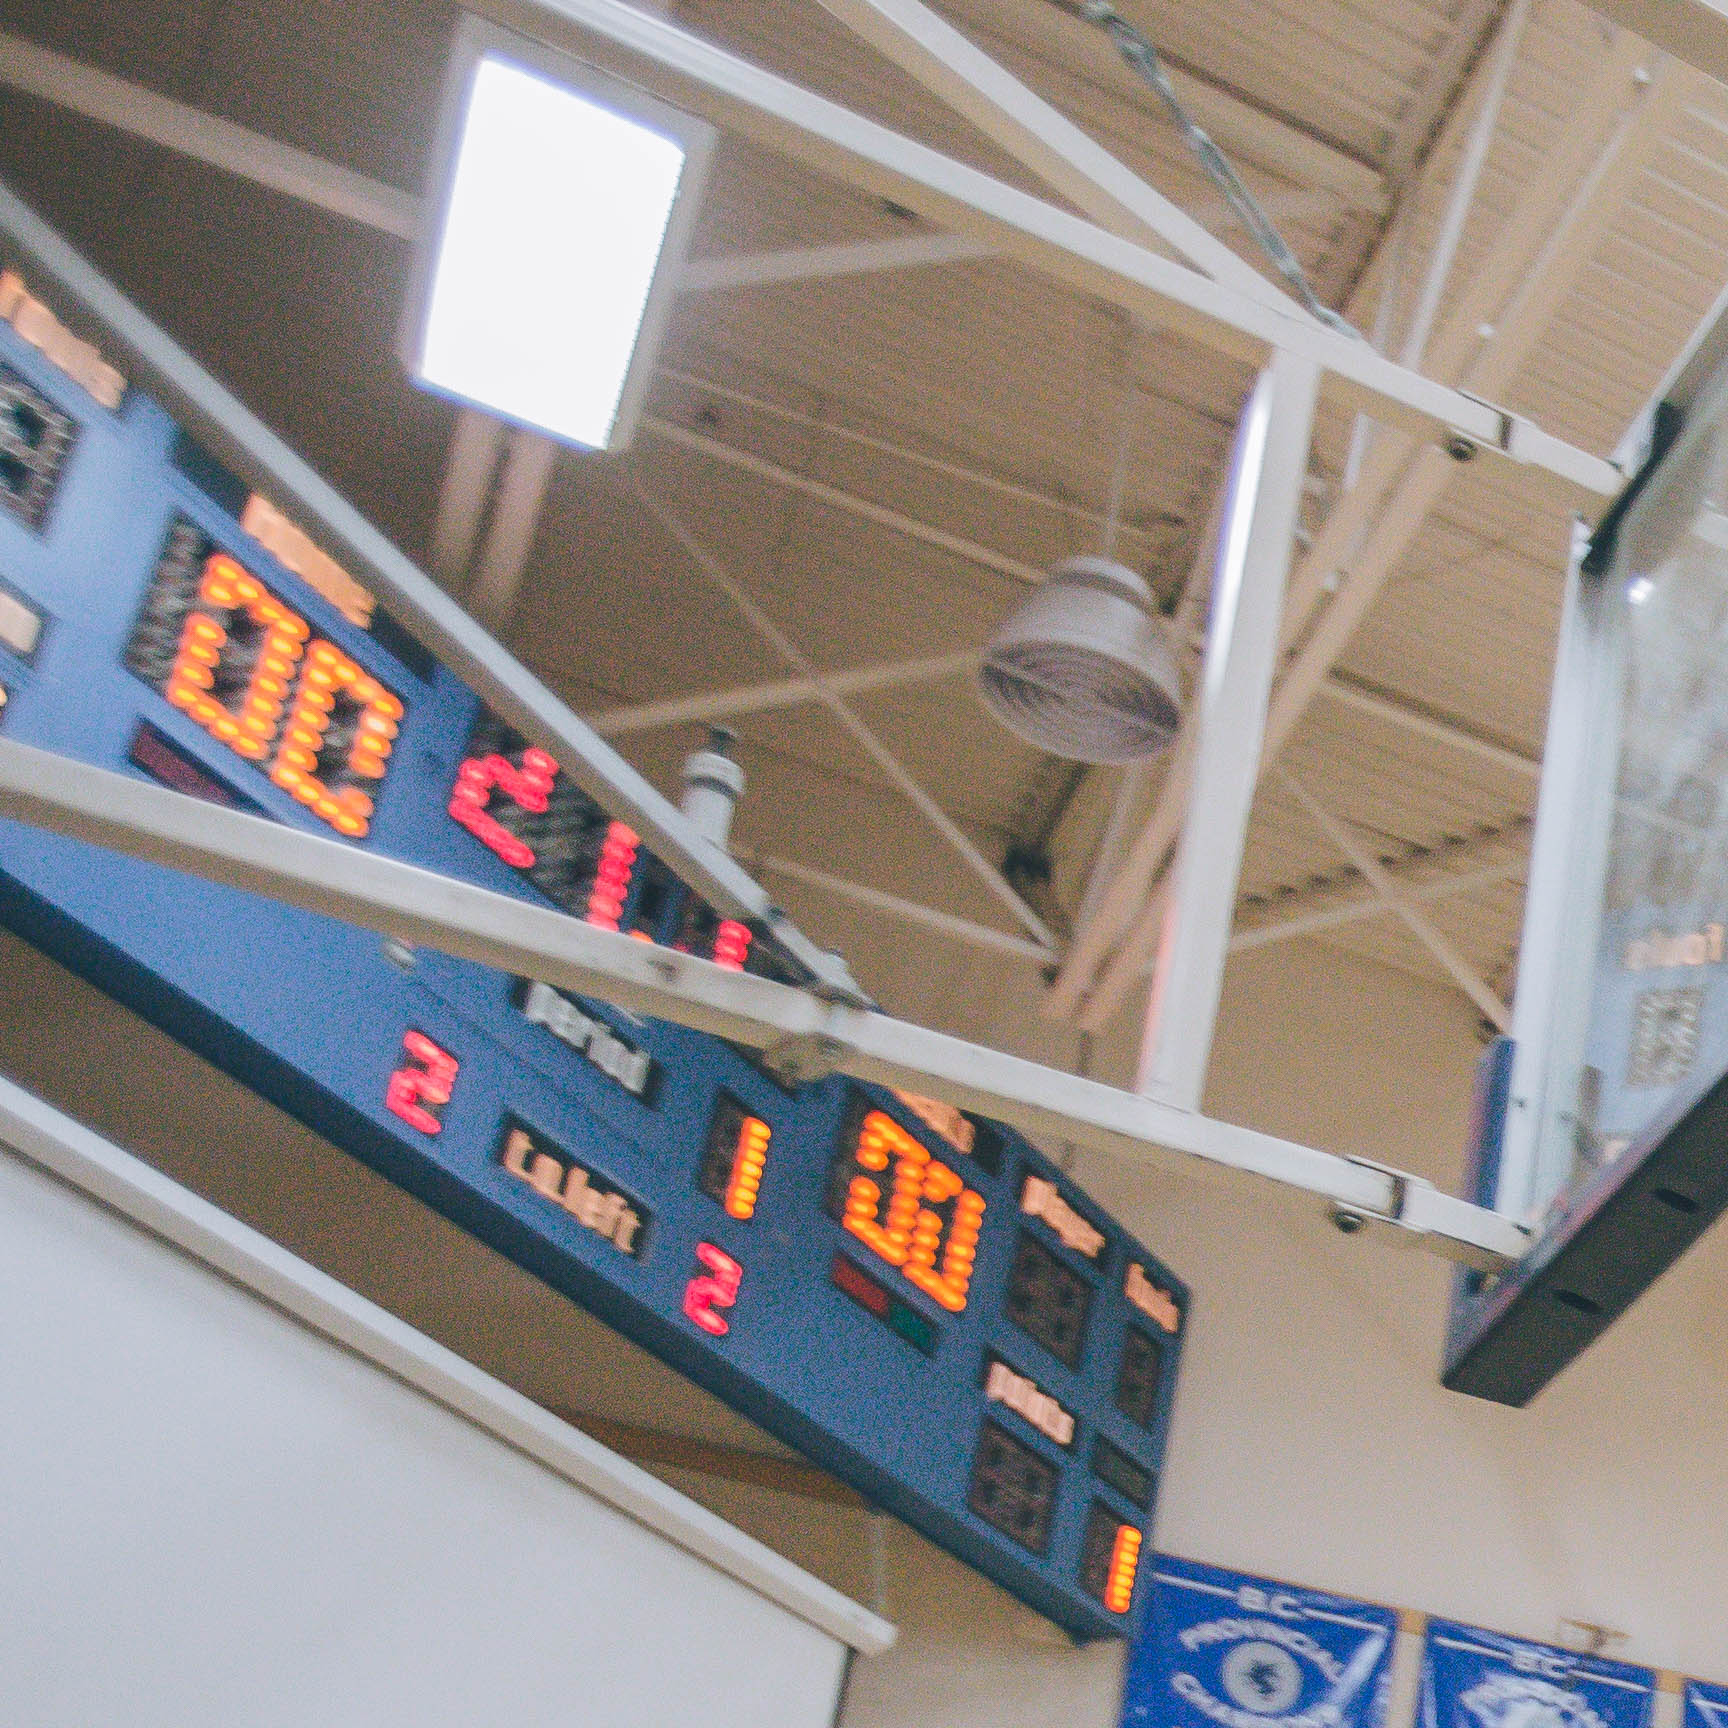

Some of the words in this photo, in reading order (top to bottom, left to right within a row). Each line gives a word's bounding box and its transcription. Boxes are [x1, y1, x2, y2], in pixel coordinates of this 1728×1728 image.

[387, 1030, 459, 1134] 2
[725, 1116, 771, 1219] 1
[684, 1241, 742, 1336] 2
[1104, 1523, 1142, 1615] 1
